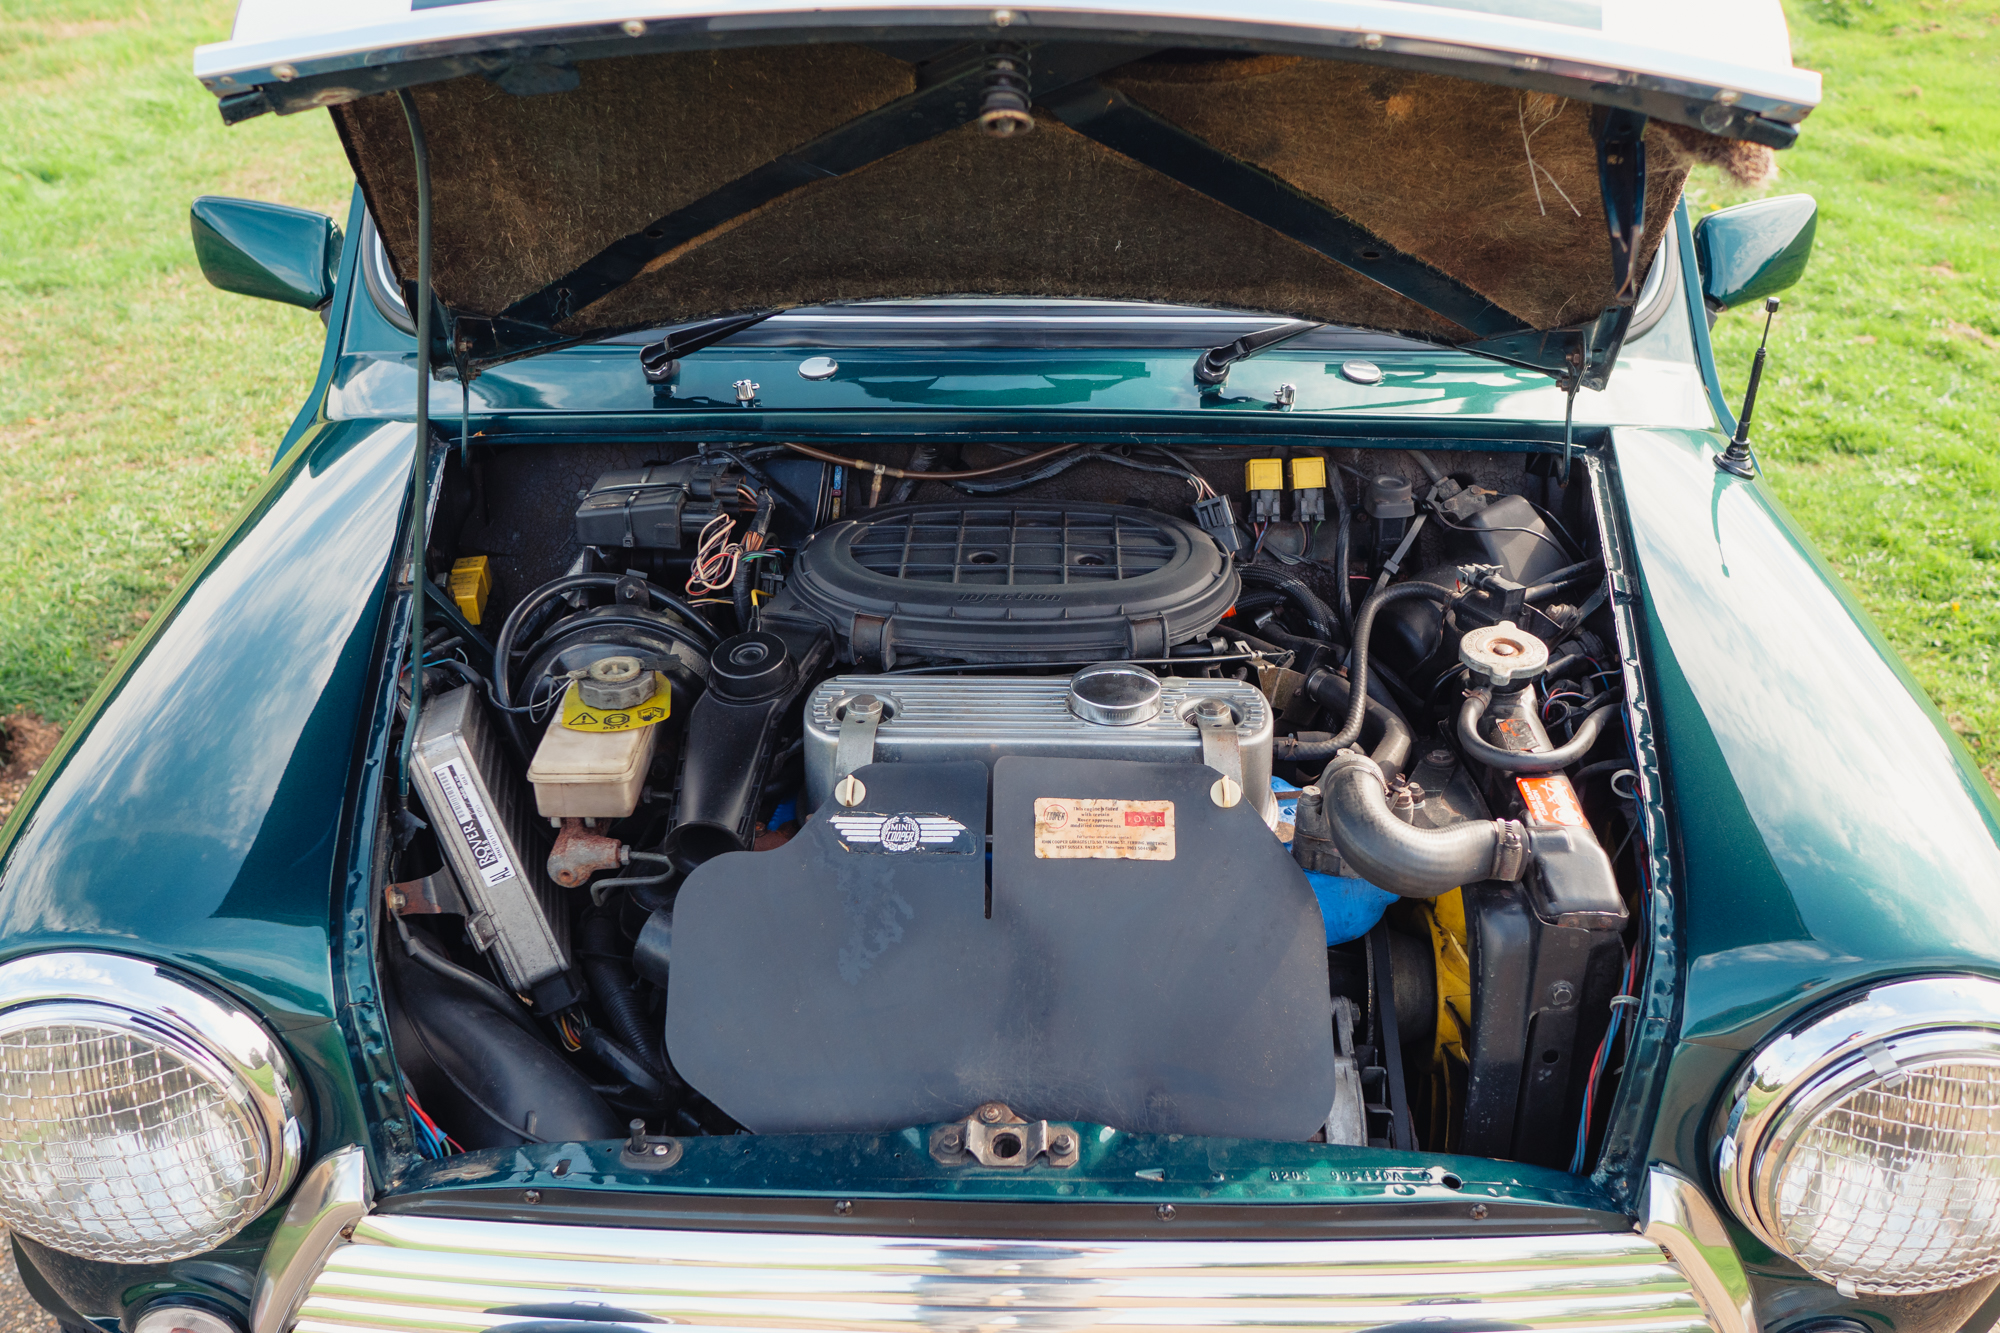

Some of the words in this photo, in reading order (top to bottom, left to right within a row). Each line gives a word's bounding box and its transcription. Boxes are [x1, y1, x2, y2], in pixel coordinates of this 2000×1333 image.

[957, 592, 1061, 603] injection
[1532, 789, 1548, 815] CAUTION
[463, 822, 488, 867] ROVER
[886, 832, 915, 841] COOPER
